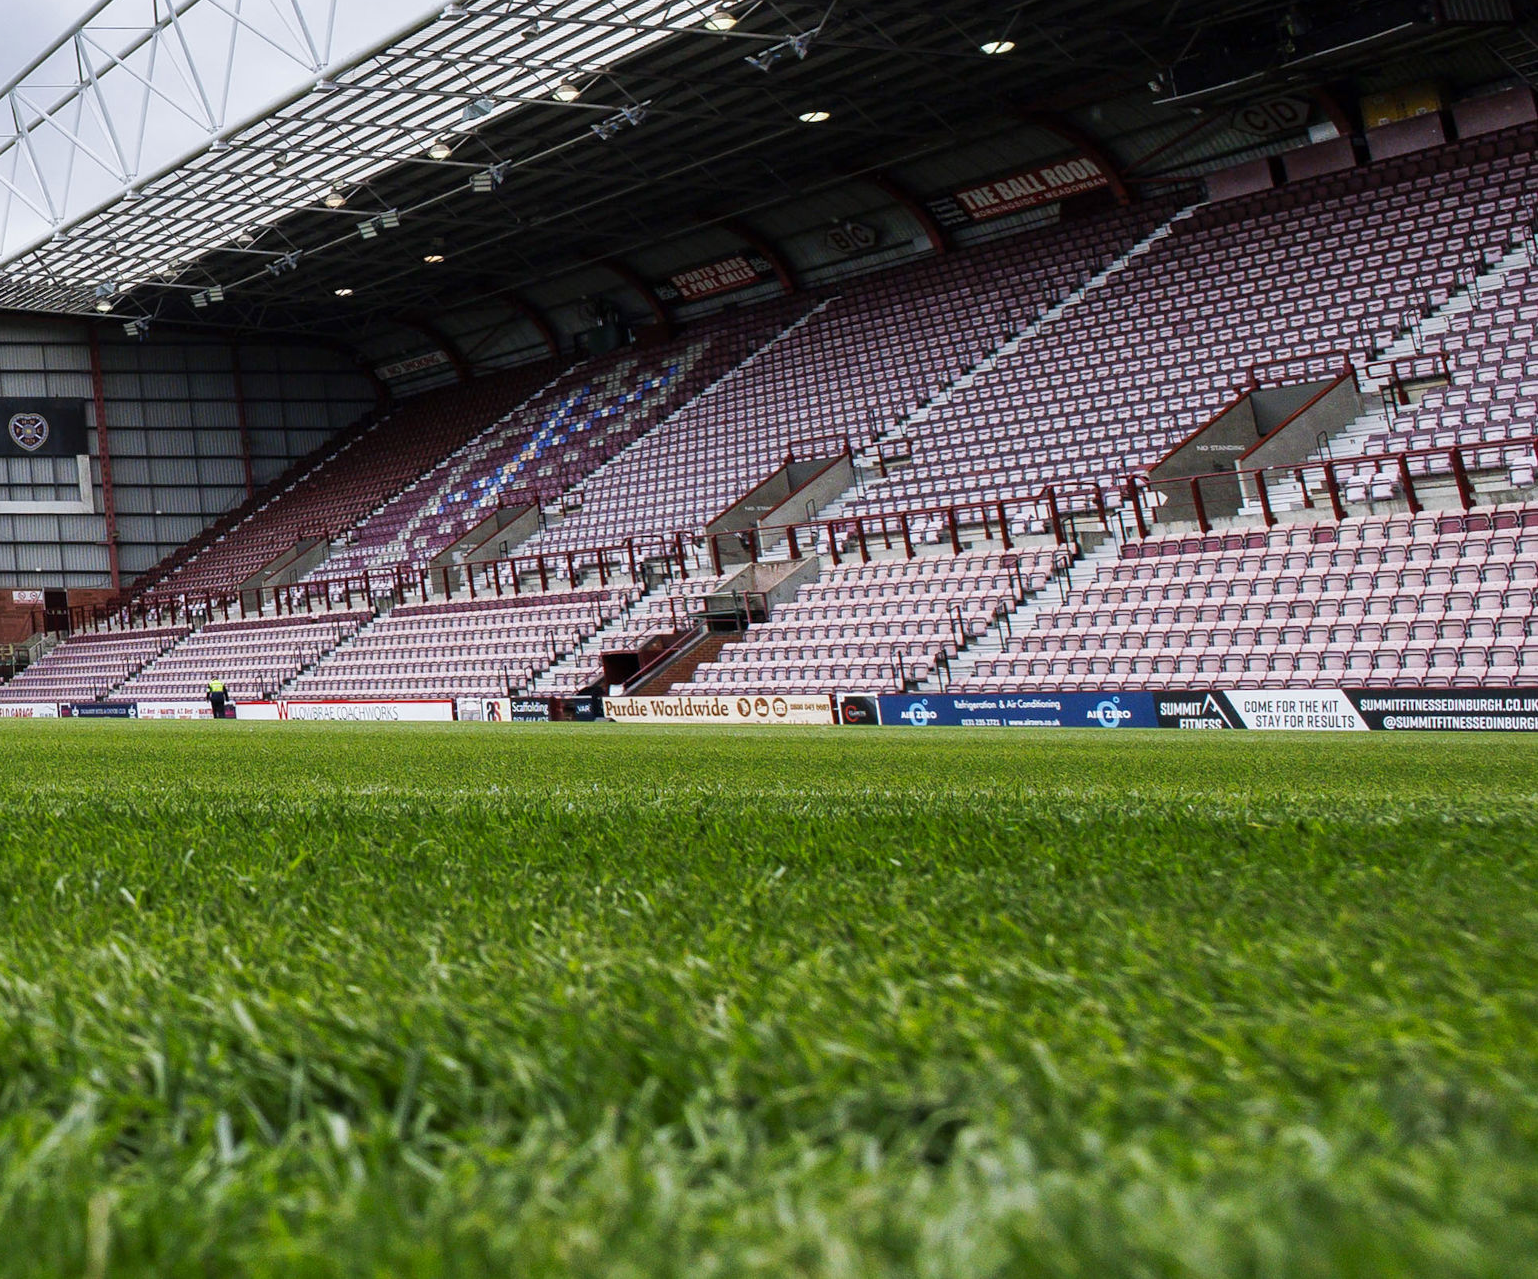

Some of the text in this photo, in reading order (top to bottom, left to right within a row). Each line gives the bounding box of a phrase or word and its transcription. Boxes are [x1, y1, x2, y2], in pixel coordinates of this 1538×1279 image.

[1244, 101, 1298, 129] C D
[956, 186, 1000, 211] THE
[994, 173, 1047, 201] BALL
[1039, 157, 1102, 189] ROOM
[852, 225, 870, 244] C
[671, 266, 717, 287] SPORTS
[689, 277, 721, 294] POOL
[277, 701, 398, 720] WILLOWBRAE COACHWORKS
[512, 702, 548, 715] Scaffolding
[605, 700, 648, 717] Purdie
[651, 698, 728, 717] Worldwide
[954, 699, 1061, 711] Refrigeration & Air Conditioning
[1160, 702, 1201, 715] SUMMIT
[1244, 701, 1338, 712] COME FOR THE KIT
[1360, 699, 1538, 711] SUMMITFITNESSEDINBURGH.CO.UK
[11, 708, 33, 717] GARAGE
[1180, 719, 1222, 729] FITNESS
[1256, 716, 1355, 728] STAY FOR RESULTS
